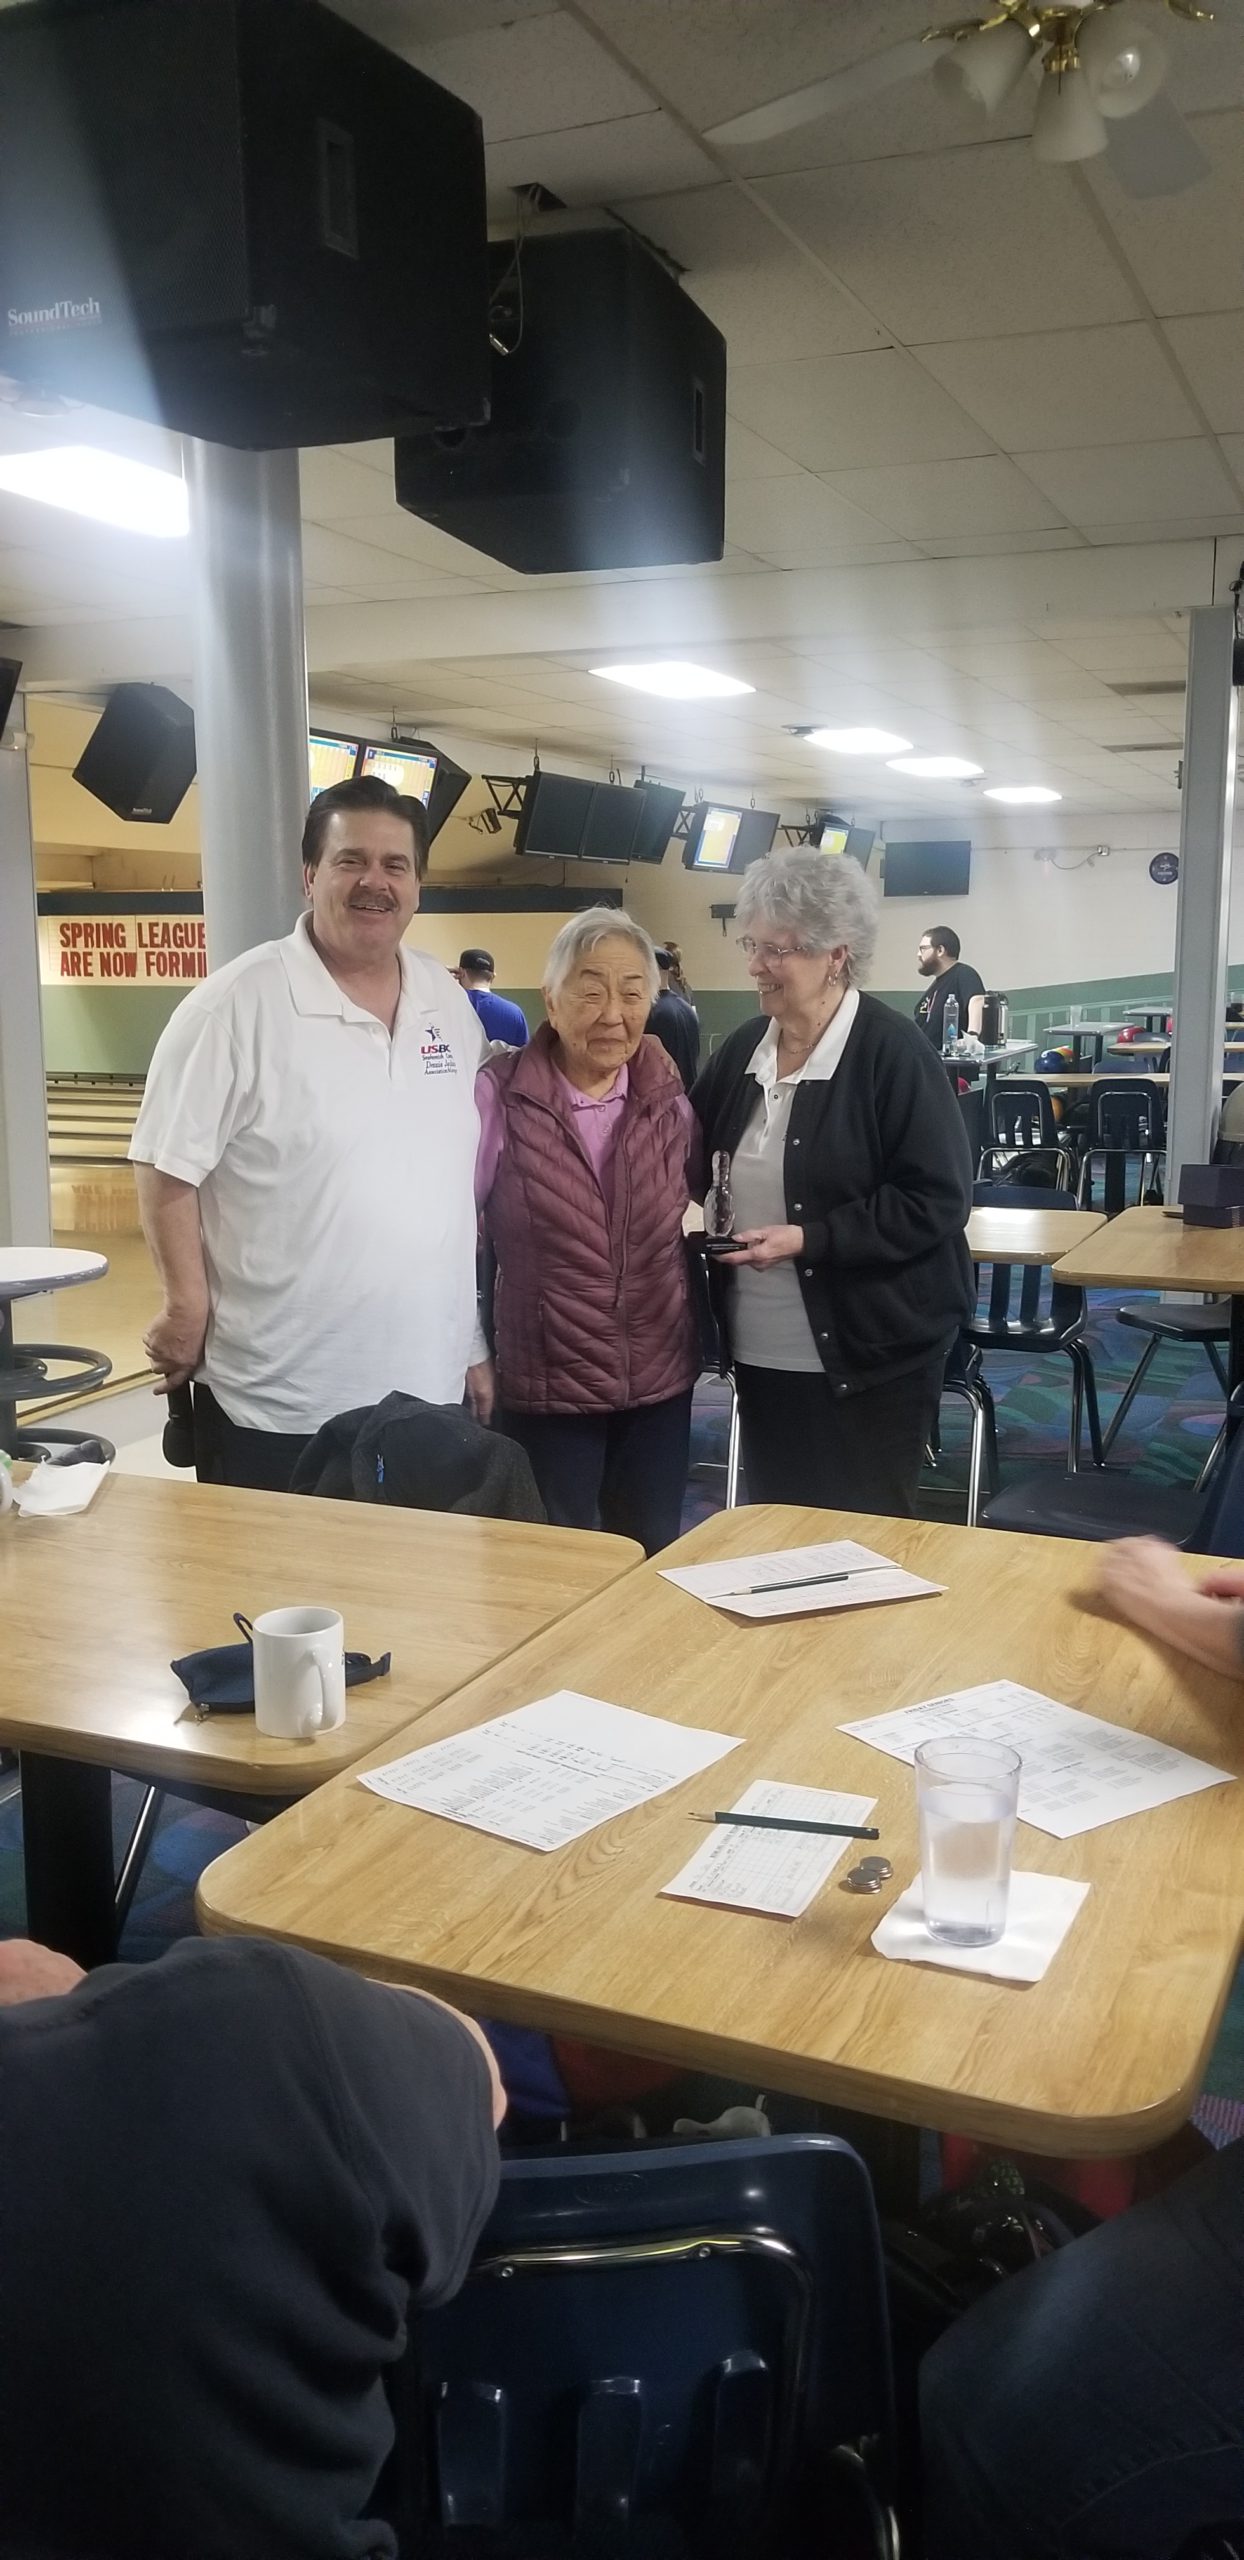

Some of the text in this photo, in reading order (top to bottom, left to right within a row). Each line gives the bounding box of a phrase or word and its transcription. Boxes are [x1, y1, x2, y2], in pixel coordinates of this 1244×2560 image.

[8, 297, 100, 326] SoundTech
[59, 921, 206, 950] SPRING LEAGUE
[60, 951, 208, 978] ARE NOW FORMI
